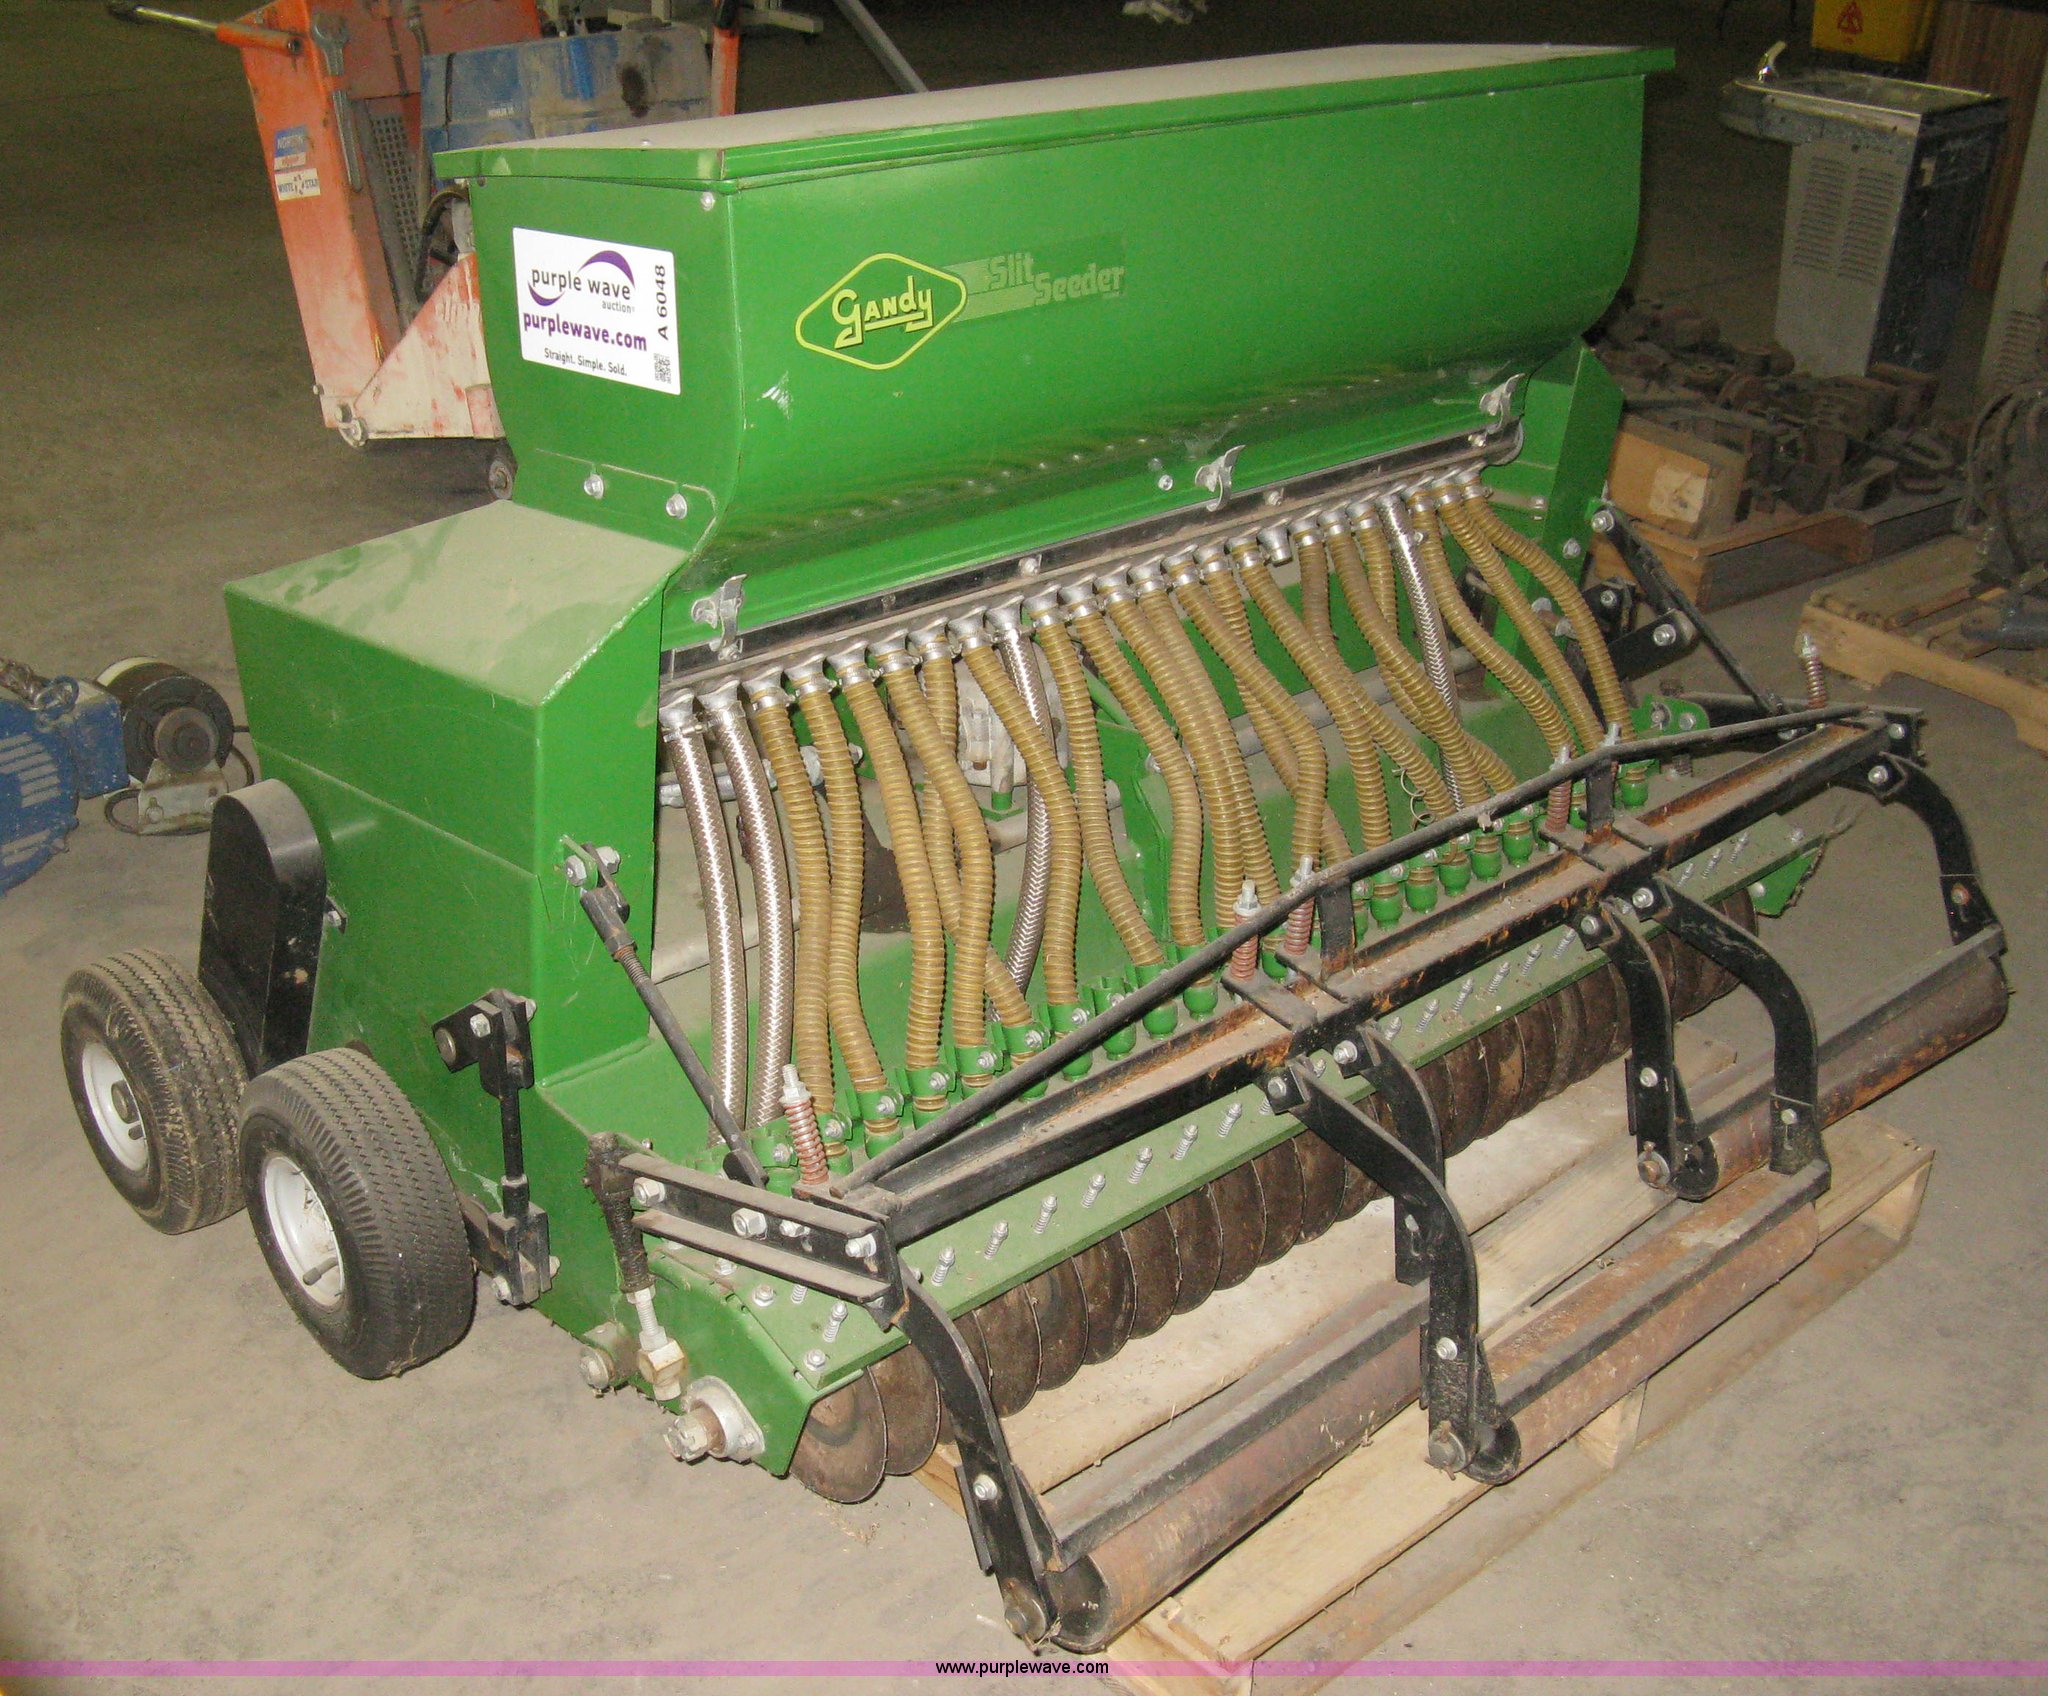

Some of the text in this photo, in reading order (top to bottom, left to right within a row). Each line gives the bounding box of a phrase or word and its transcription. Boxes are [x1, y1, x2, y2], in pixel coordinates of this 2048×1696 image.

[531, 268, 631, 300] purple wave
[987, 252, 1035, 289] Slit
[1033, 262, 1126, 306] Seeder
[601, 300, 633, 314] auction
[654, 264, 669, 341] A 6048
[523, 311, 648, 352] purplewave.com
[544, 347, 628, 377] Straight. Simple. Sold.
